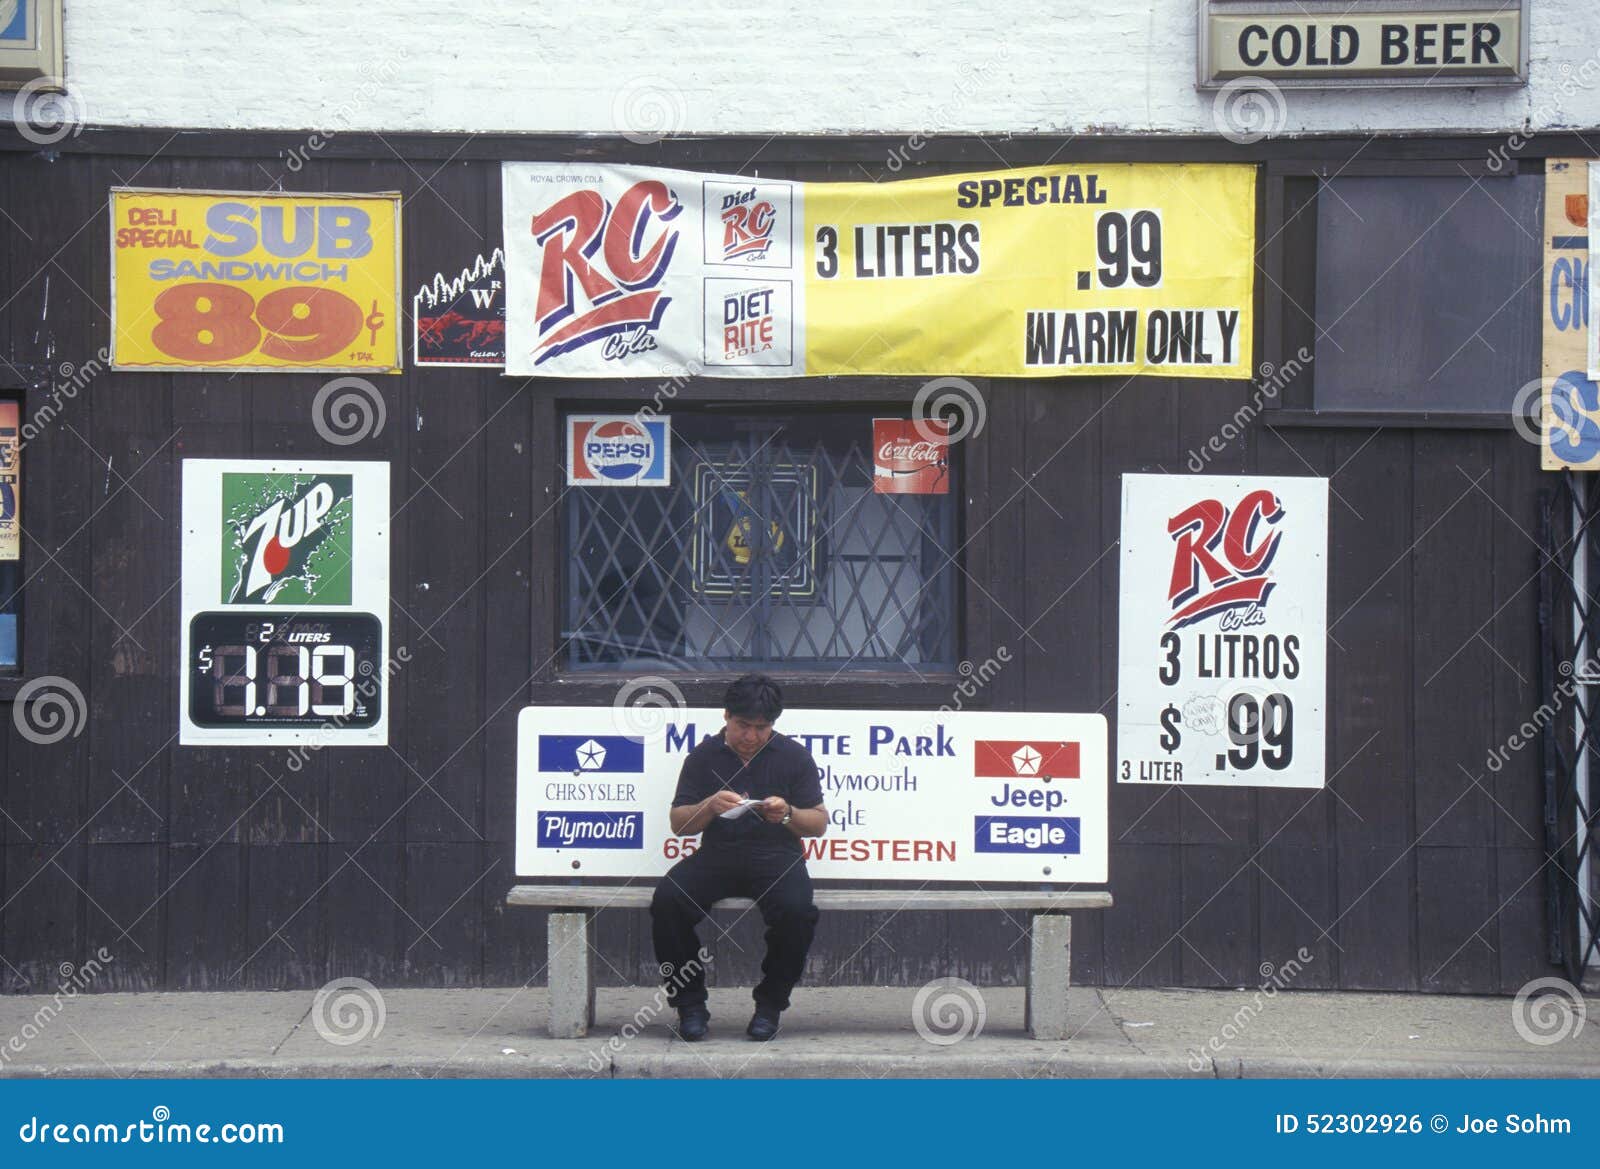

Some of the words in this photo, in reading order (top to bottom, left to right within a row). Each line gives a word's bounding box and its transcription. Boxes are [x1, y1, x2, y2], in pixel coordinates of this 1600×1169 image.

[1238, 24, 1360, 66] COLD
[1380, 23, 1501, 65] BEER
[530, 175, 553, 184] ROYAL
[556, 175, 583, 184] CROWN
[584, 175, 604, 184] COLA
[957, 174, 1107, 209] SPECIAL
[722, 187, 757, 210] Diet
[128, 207, 177, 226] DELI
[203, 202, 374, 259] SUB
[722, 201, 776, 252] RC
[116, 228, 200, 250] SPECIAL
[815, 225, 839, 279] 3
[854, 222, 980, 279] LITERS
[1077, 210, 1162, 290] .99
[150, 259, 348, 283] SANDWICH
[531, 179, 683, 337] RC
[724, 289, 774, 325] DIET
[1550, 258, 1588, 332] CI
[601, 325, 658, 361] Cola
[724, 316, 773, 352] RITE
[725, 343, 773, 360] COLA
[1025, 310, 1137, 366] WARM
[1146, 310, 1239, 365] ONLY
[587, 443, 651, 459] PEPSI
[242, 482, 334, 598] 7UP
[1167, 489, 1287, 609] RC
[259, 623, 275, 642] 2
[287, 633, 332, 643] LITERS
[1219, 601, 1265, 631] Cola
[1158, 632, 1181, 686] 3
[1198, 634, 1300, 680] LITROS
[1215, 693, 1294, 771] .99
[1122, 760, 1131, 780] 3
[1140, 760, 1183, 781] LITER
[545, 783, 637, 801] CHRSYSLER
[991, 783, 1063, 812] Jeep
[545, 815, 636, 845] Plymouth
[990, 822, 1066, 848] Eagle
[801, 839, 956, 862] WESTERN
